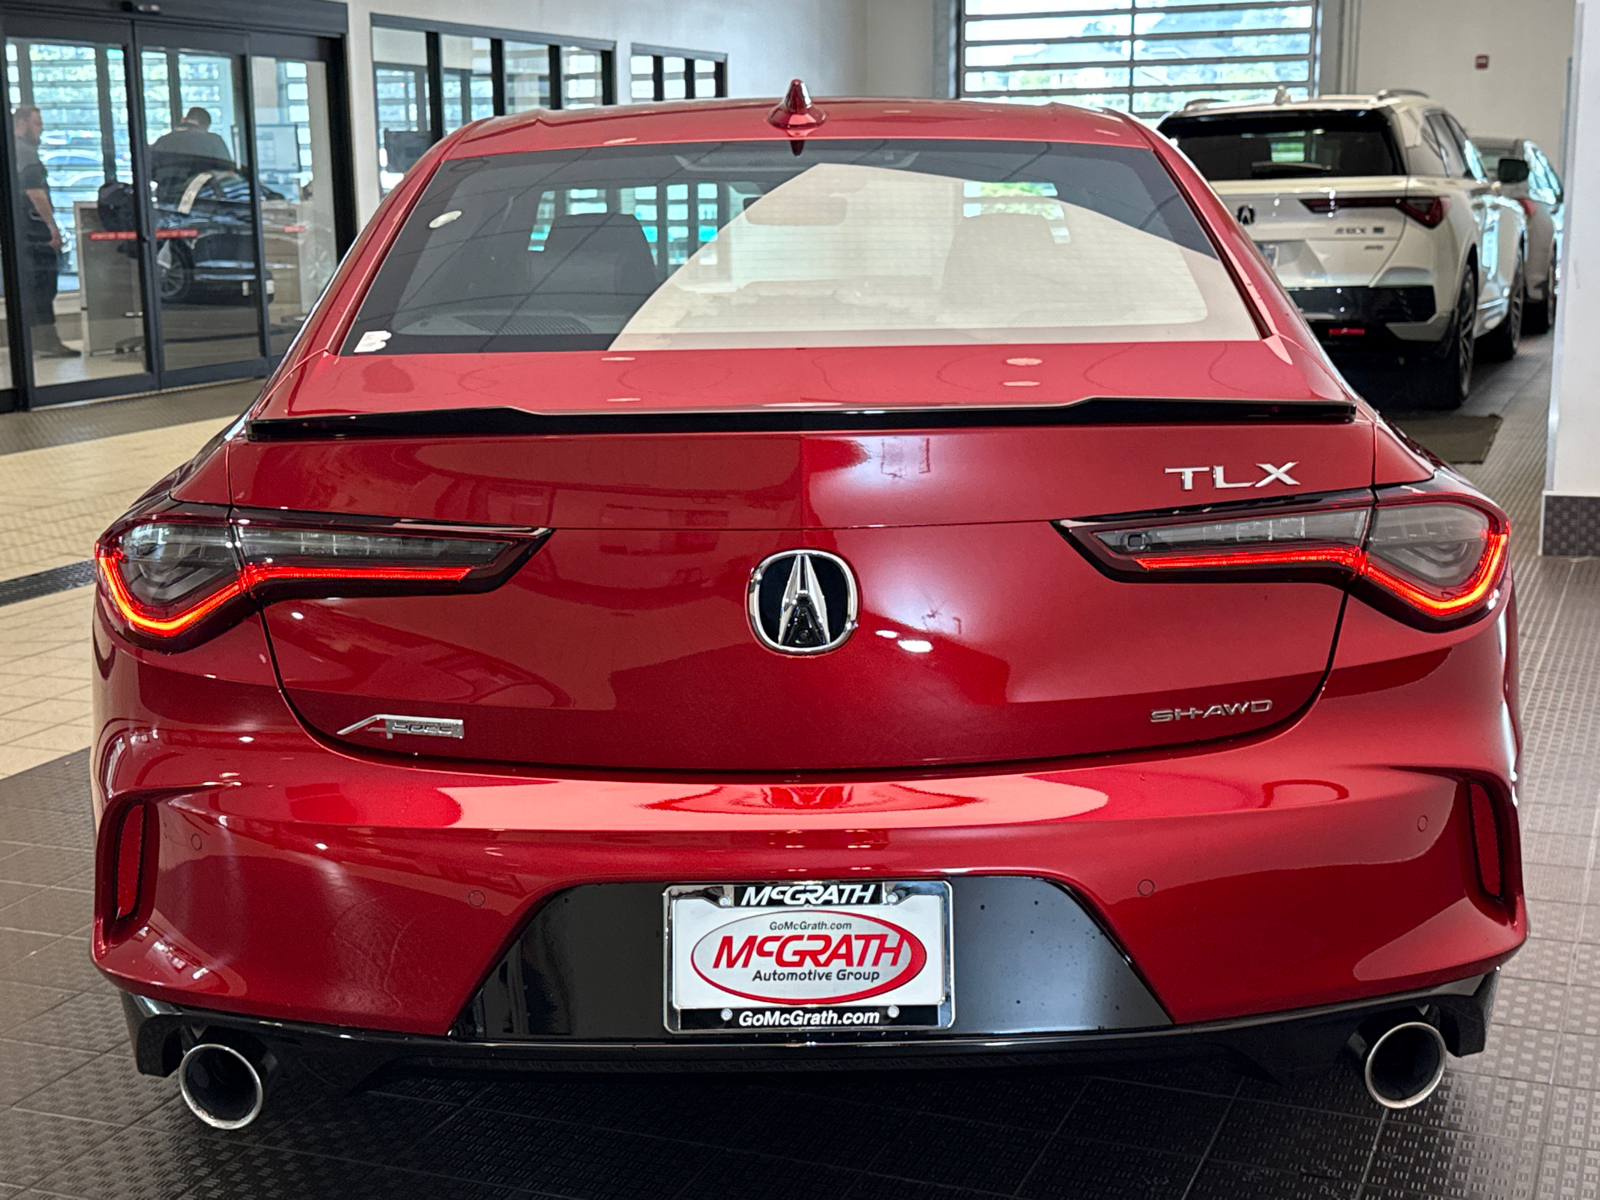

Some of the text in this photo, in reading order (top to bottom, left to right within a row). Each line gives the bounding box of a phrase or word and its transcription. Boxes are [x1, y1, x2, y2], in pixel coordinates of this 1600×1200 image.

[1164, 461, 1301, 490] TLX
[1150, 699, 1273, 723] SH-AWD
[740, 884, 876, 906] McGRATH
[769, 920, 852, 931] GoMcGrath.com
[712, 933, 905, 969] McGRATH
[751, 969, 880, 983] Automotive Group
[738, 1010, 880, 1027] GoMcGrath.com
